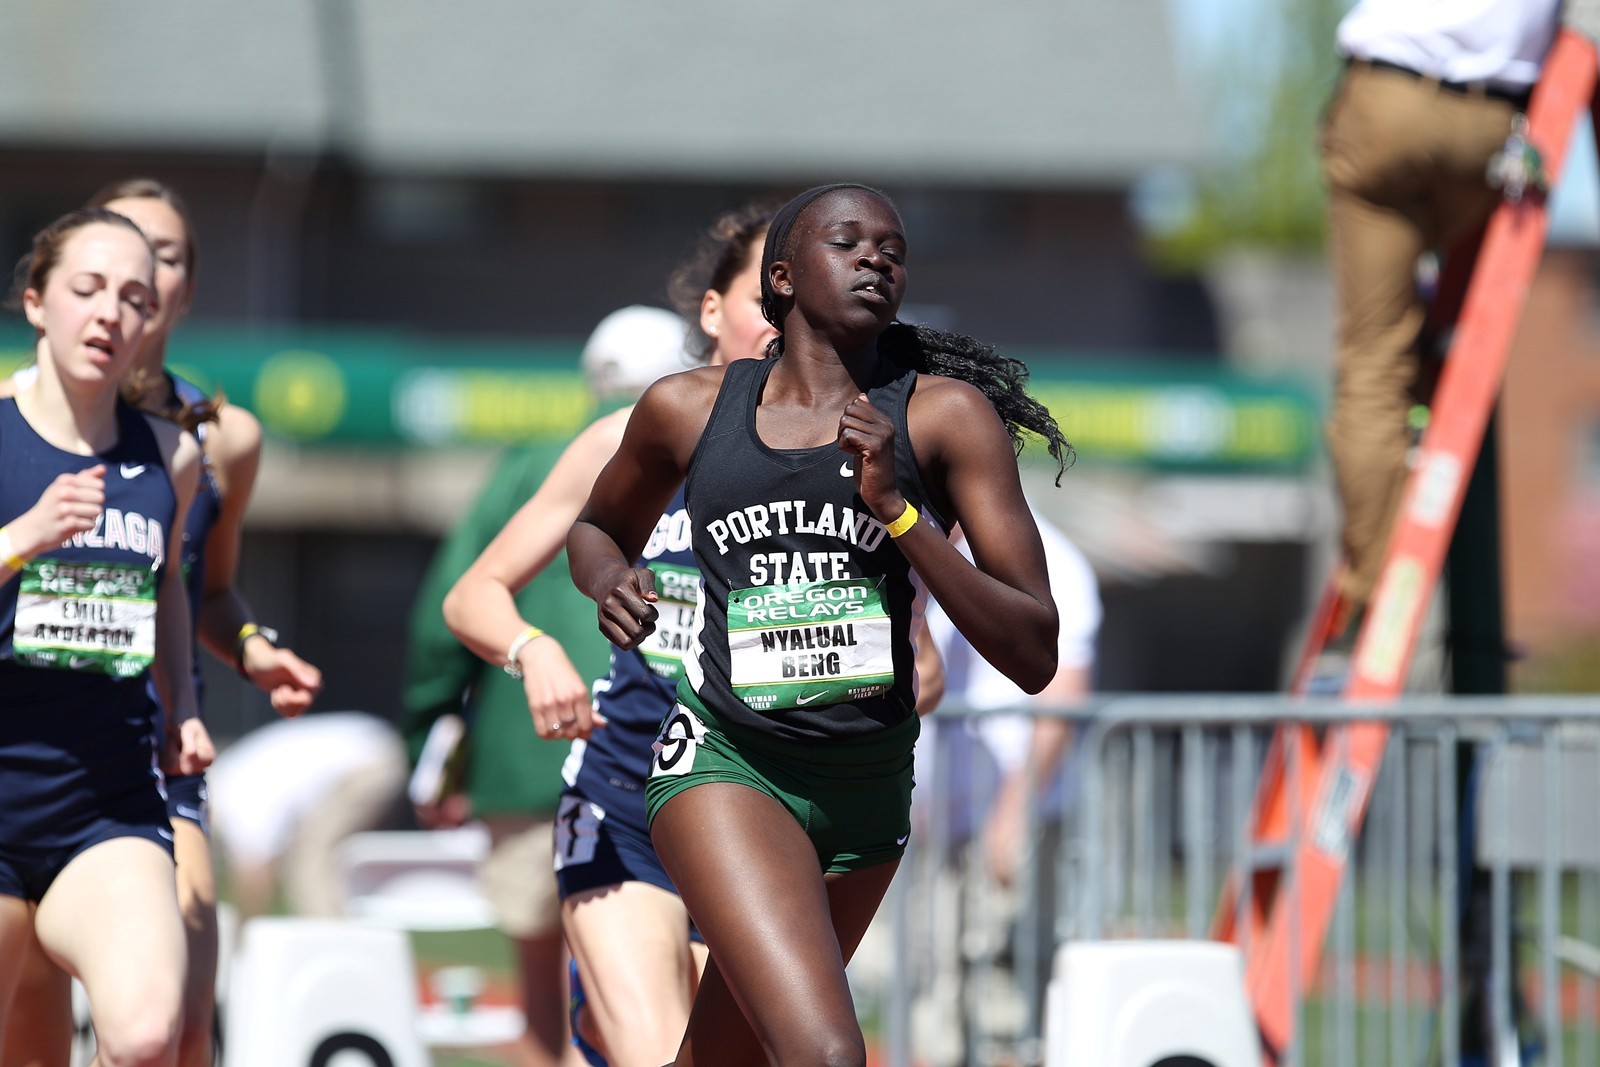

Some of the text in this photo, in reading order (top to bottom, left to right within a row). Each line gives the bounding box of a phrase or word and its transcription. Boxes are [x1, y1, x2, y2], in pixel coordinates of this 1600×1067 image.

[706, 500, 888, 555] PORTLAND
[750, 551, 850, 587] STATE
[743, 586, 868, 610] OREGON
[746, 600, 865, 623] RELAYS
[760, 623, 858, 653] NYALUAL
[781, 651, 841, 678] BENG
[743, 694, 778, 703] HAYWARD
[848, 685, 880, 695] HAYWARD
[854, 691, 872, 699] FIELD
